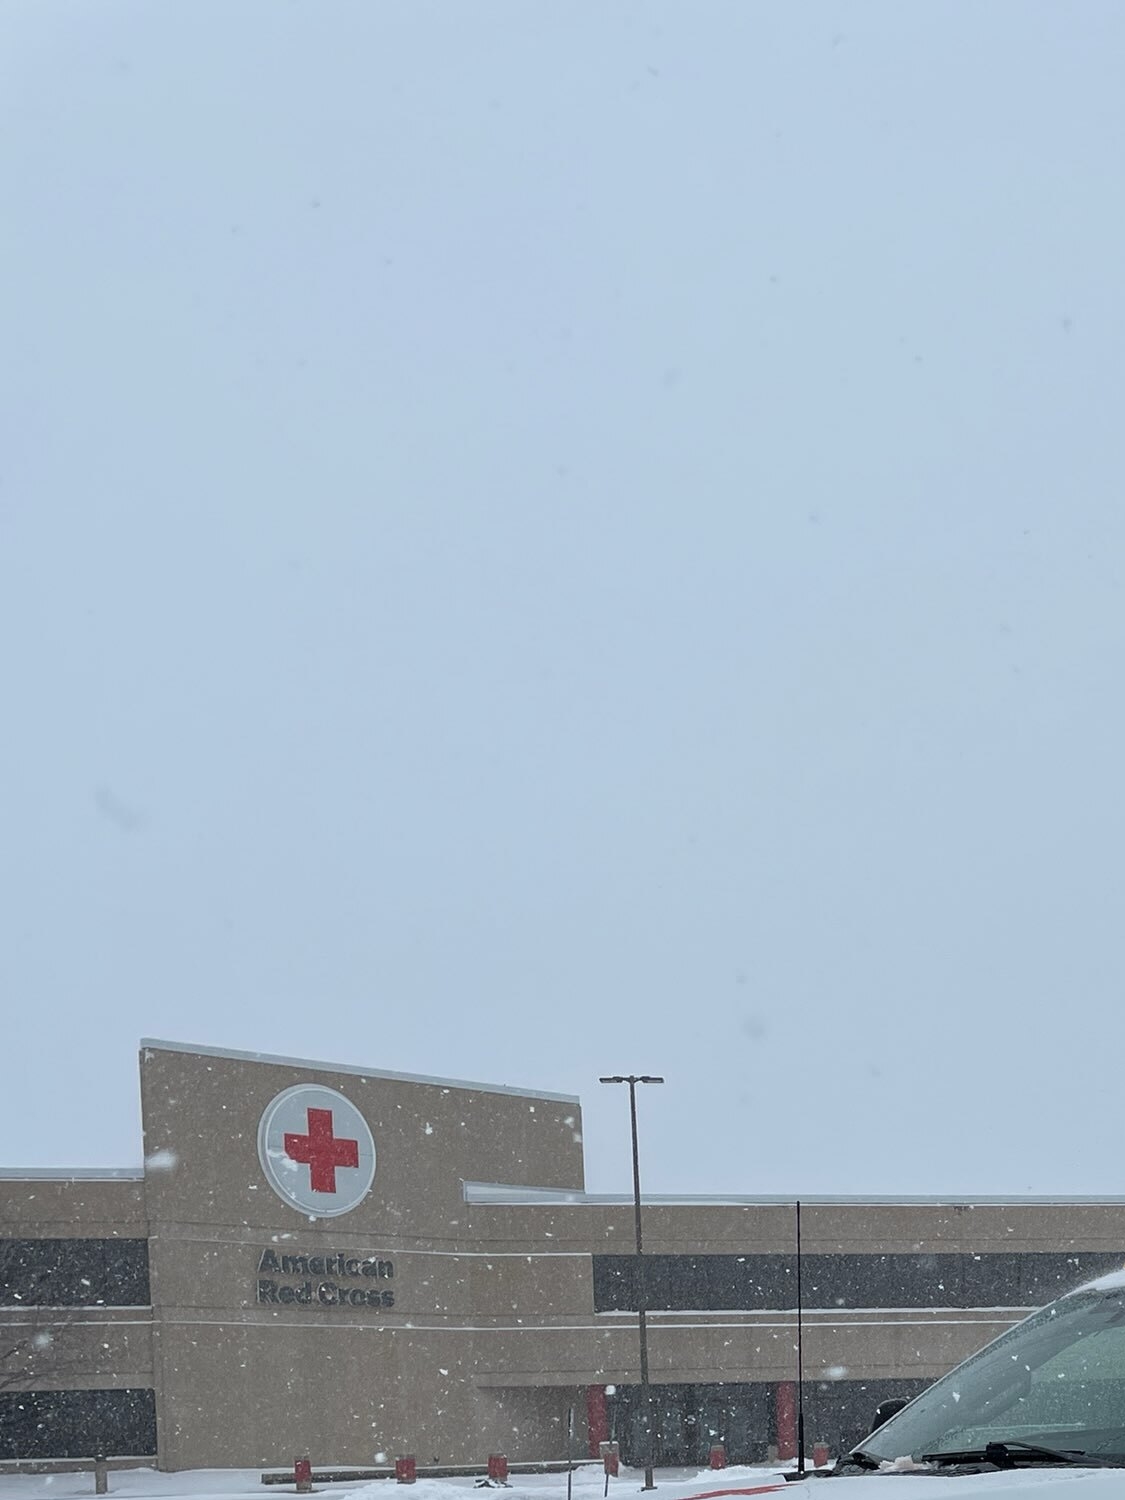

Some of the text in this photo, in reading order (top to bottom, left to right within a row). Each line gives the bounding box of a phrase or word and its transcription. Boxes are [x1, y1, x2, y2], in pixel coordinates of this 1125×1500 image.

[257, 1248, 395, 1279] American
[256, 1279, 396, 1308] Red Cross
